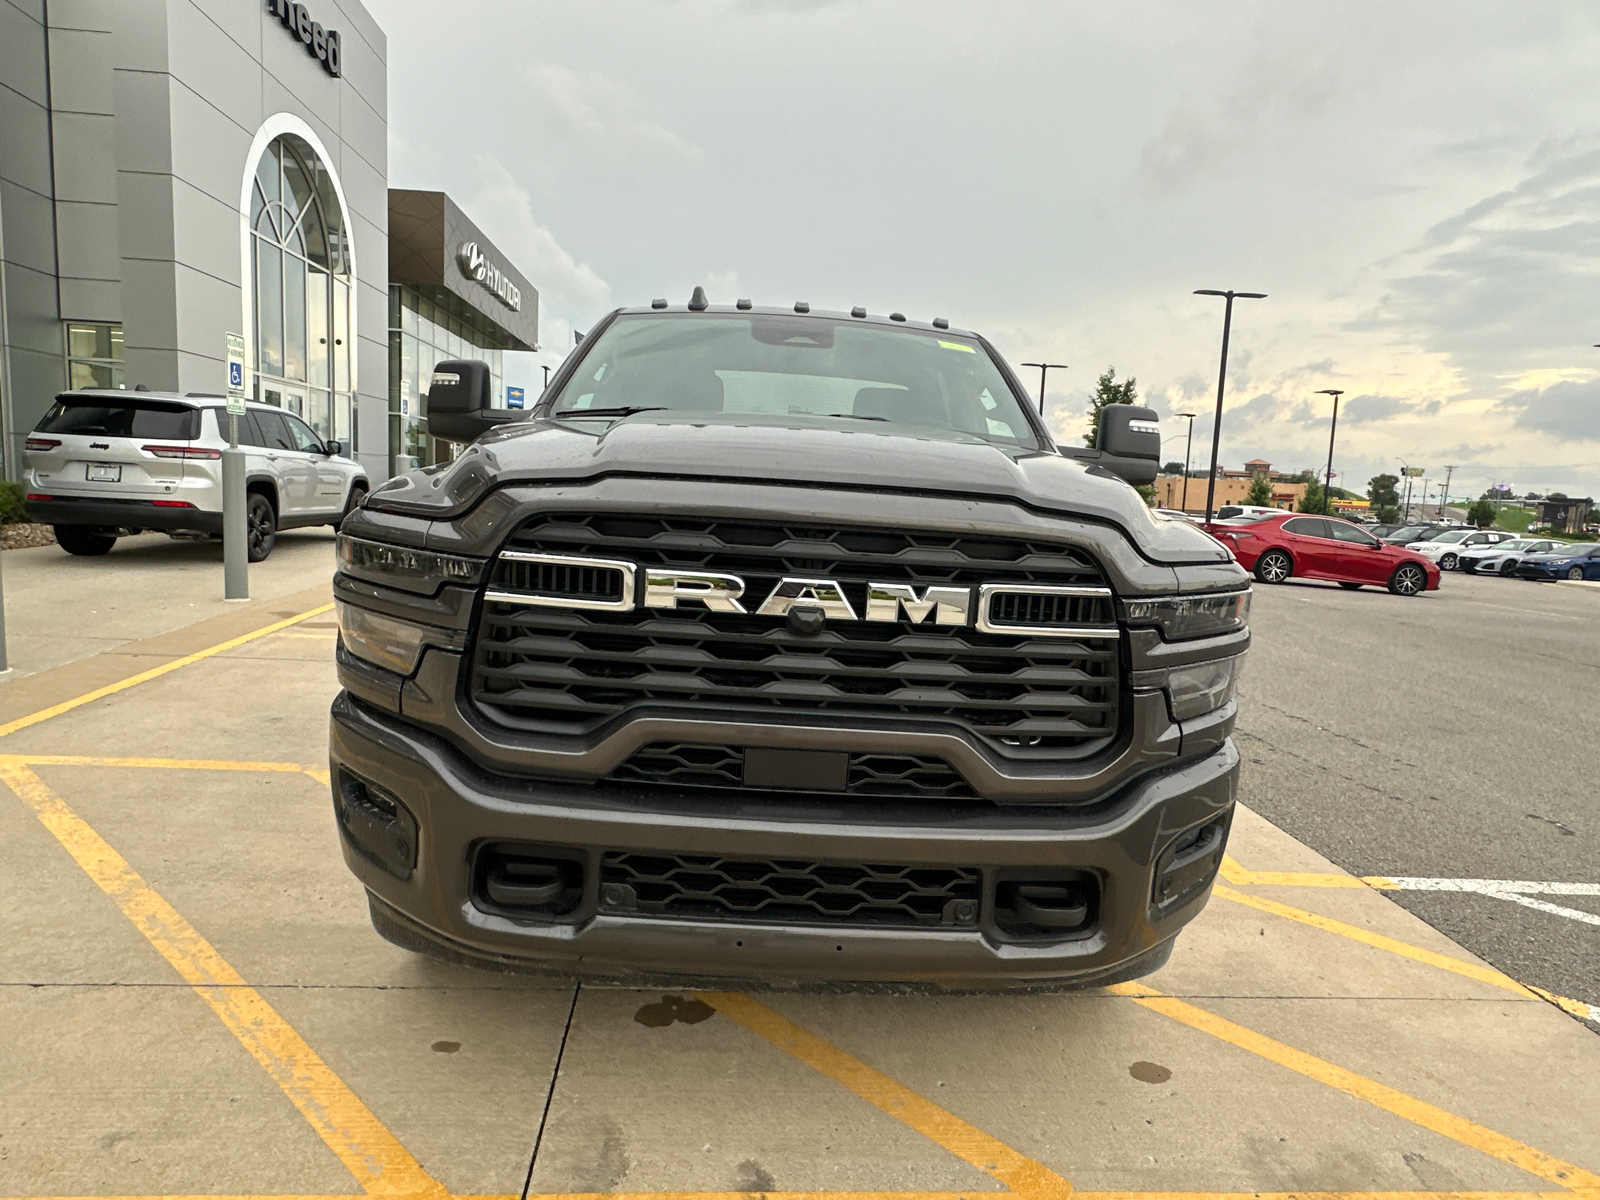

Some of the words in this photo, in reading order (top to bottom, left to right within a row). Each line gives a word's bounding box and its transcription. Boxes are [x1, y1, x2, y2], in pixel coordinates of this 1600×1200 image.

[486, 260, 520, 311] HYUNDAI
[89, 441, 110, 450] Jeep
[644, 568, 971, 626] RAM
